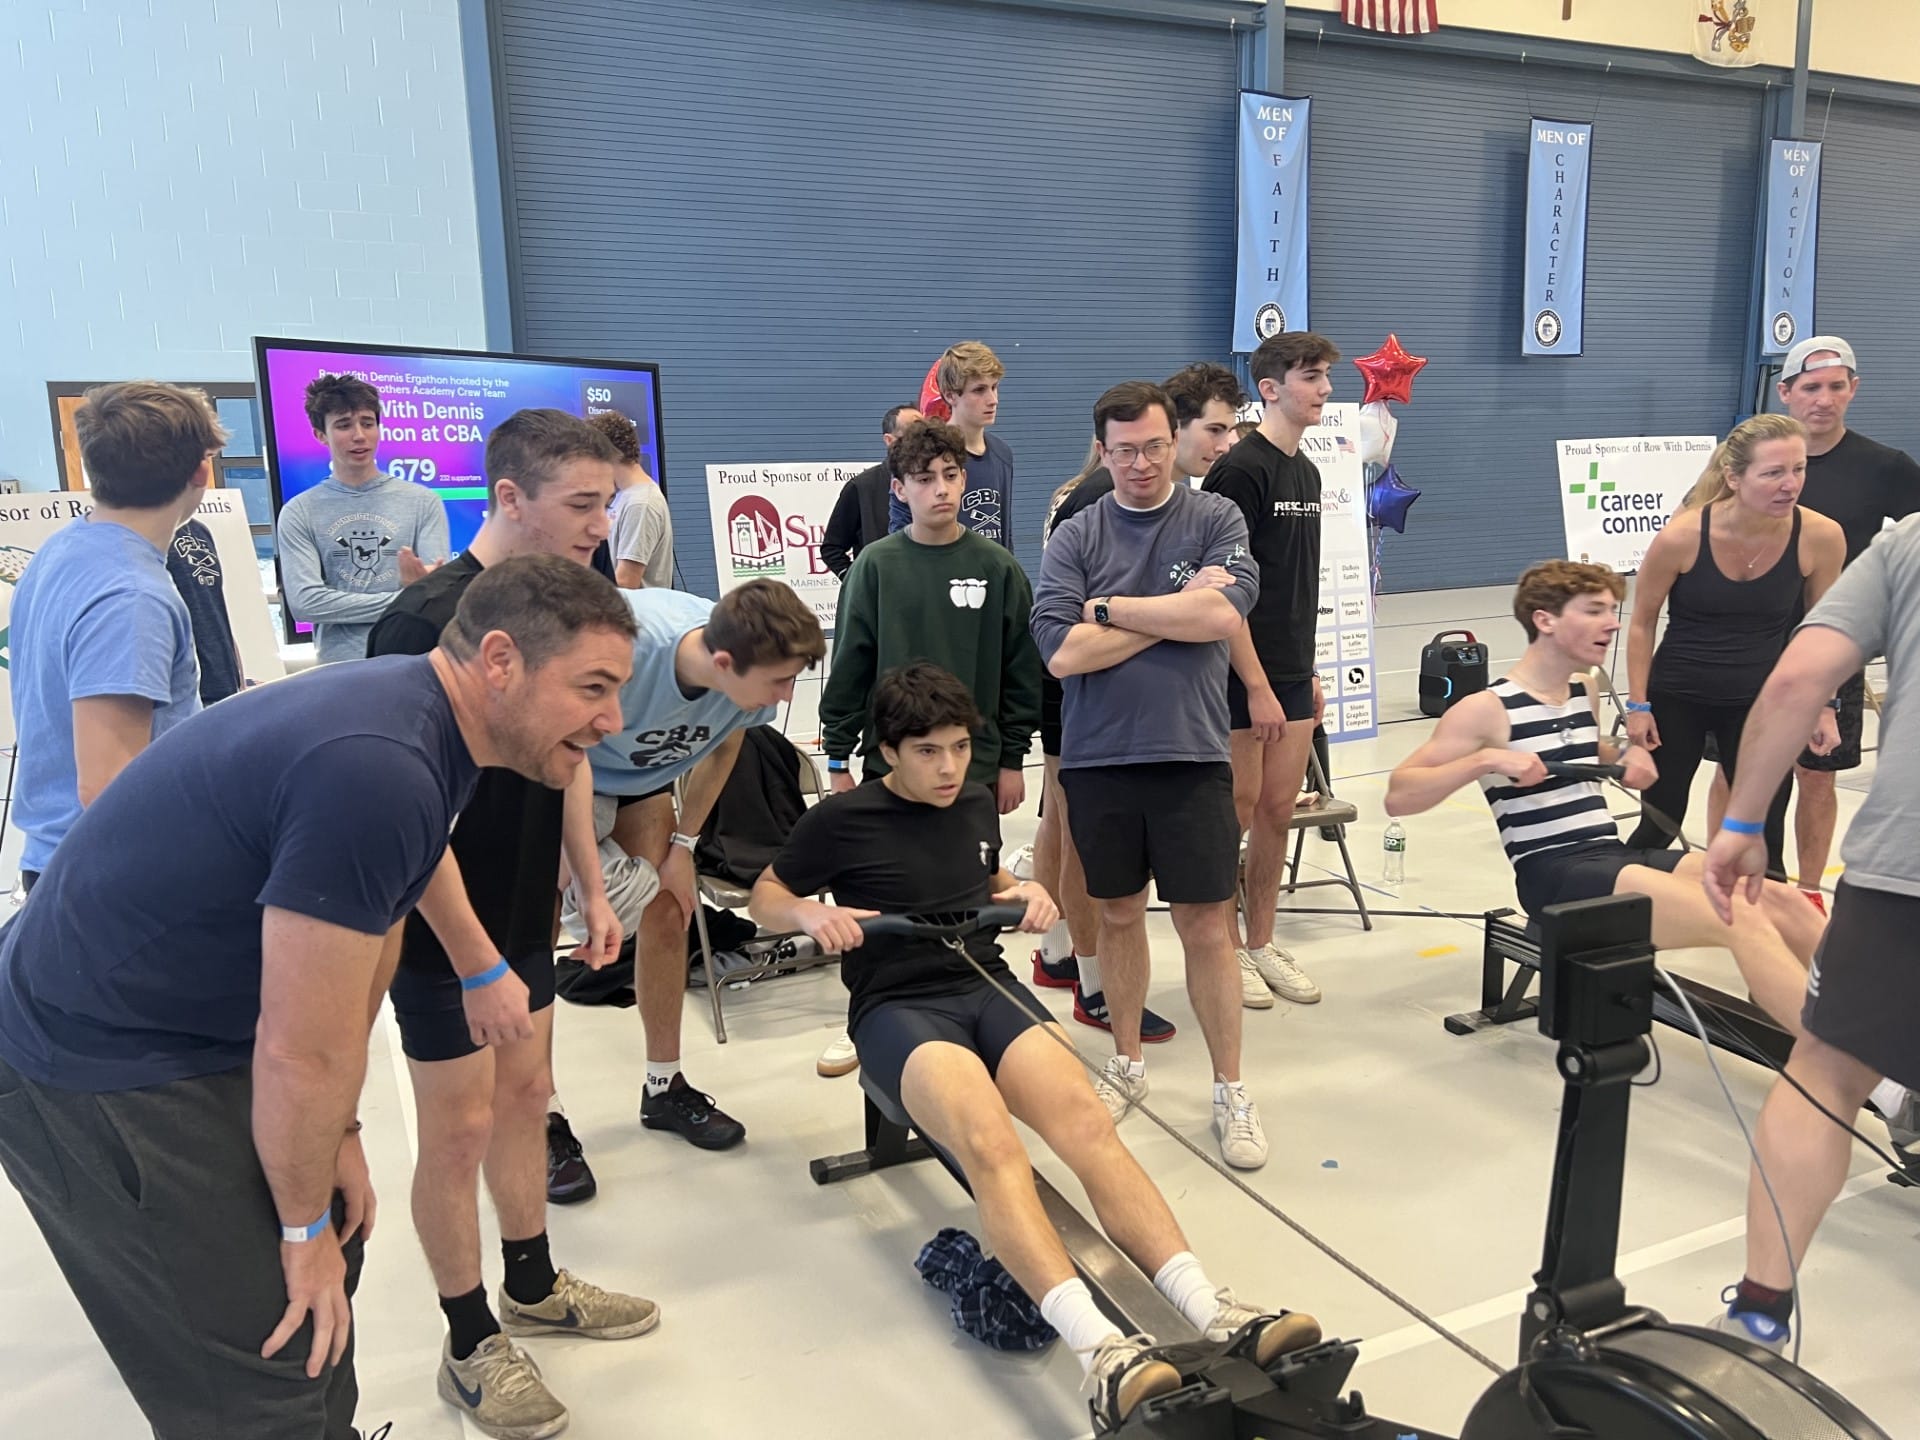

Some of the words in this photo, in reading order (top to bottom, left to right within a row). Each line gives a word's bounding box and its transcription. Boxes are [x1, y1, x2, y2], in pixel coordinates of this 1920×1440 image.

[1256, 104, 1292, 122] MEN
[1263, 126, 1287, 141] OF
[1537, 128, 1564, 145] MEN
[1566, 132, 1587, 146] OF
[1783, 148, 1810, 162] MEN
[1789, 165, 1807, 177] OF
[1266, 154, 1282, 282] FAITH
[1545, 153, 1565, 302] CHARACTER
[1782, 186, 1800, 298] ACTION
[370, 372, 403, 383] Dennis
[405, 373, 448, 386] Ergathon
[450, 376, 480, 386] hosted
[482, 377, 493, 388] by
[494, 379, 510, 388] the
[412, 386, 456, 398] Academy
[457, 387, 481, 397] Crew
[482, 388, 506, 398] Team
[587, 386, 612, 403] $50
[423, 401, 485, 420] Dennis
[421, 425, 441, 442] at
[444, 424, 483, 442] CBA
[1565, 444, 1592, 456] Proud
[1595, 443, 1629, 457] Sponsor
[1632, 442, 1642, 453] of
[1644, 441, 1661, 452] Row
[1664, 441, 1683, 452] With
[1685, 440, 1712, 452] Dennis
[718, 470, 757, 484] Proud
[762, 470, 812, 487] Sponsor
[817, 468, 830, 482] of
[40, 500, 61, 520] of
[1600, 493, 1664, 512] career
[790, 579, 829, 587] MARINE
[831, 578, 839, 586] &
[1346, 719, 1369, 727] Company
[635, 724, 710, 745] CBA
